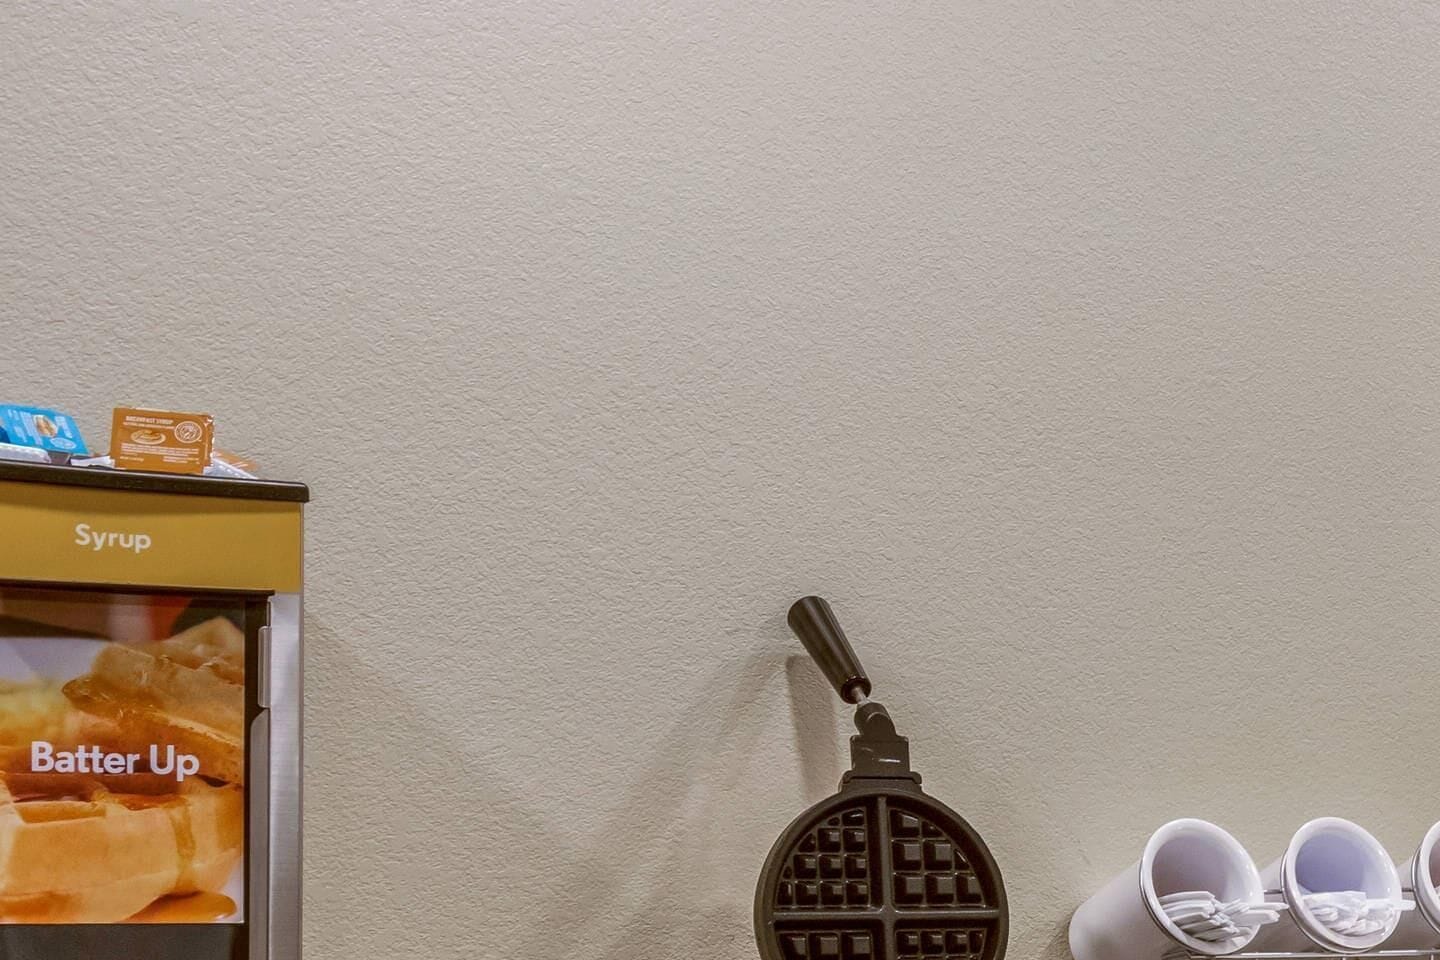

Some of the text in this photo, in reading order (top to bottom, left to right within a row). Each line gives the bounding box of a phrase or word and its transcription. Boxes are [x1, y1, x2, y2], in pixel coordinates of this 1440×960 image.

[74, 523, 151, 553] Syrup
[31, 740, 200, 782] Batter Up
